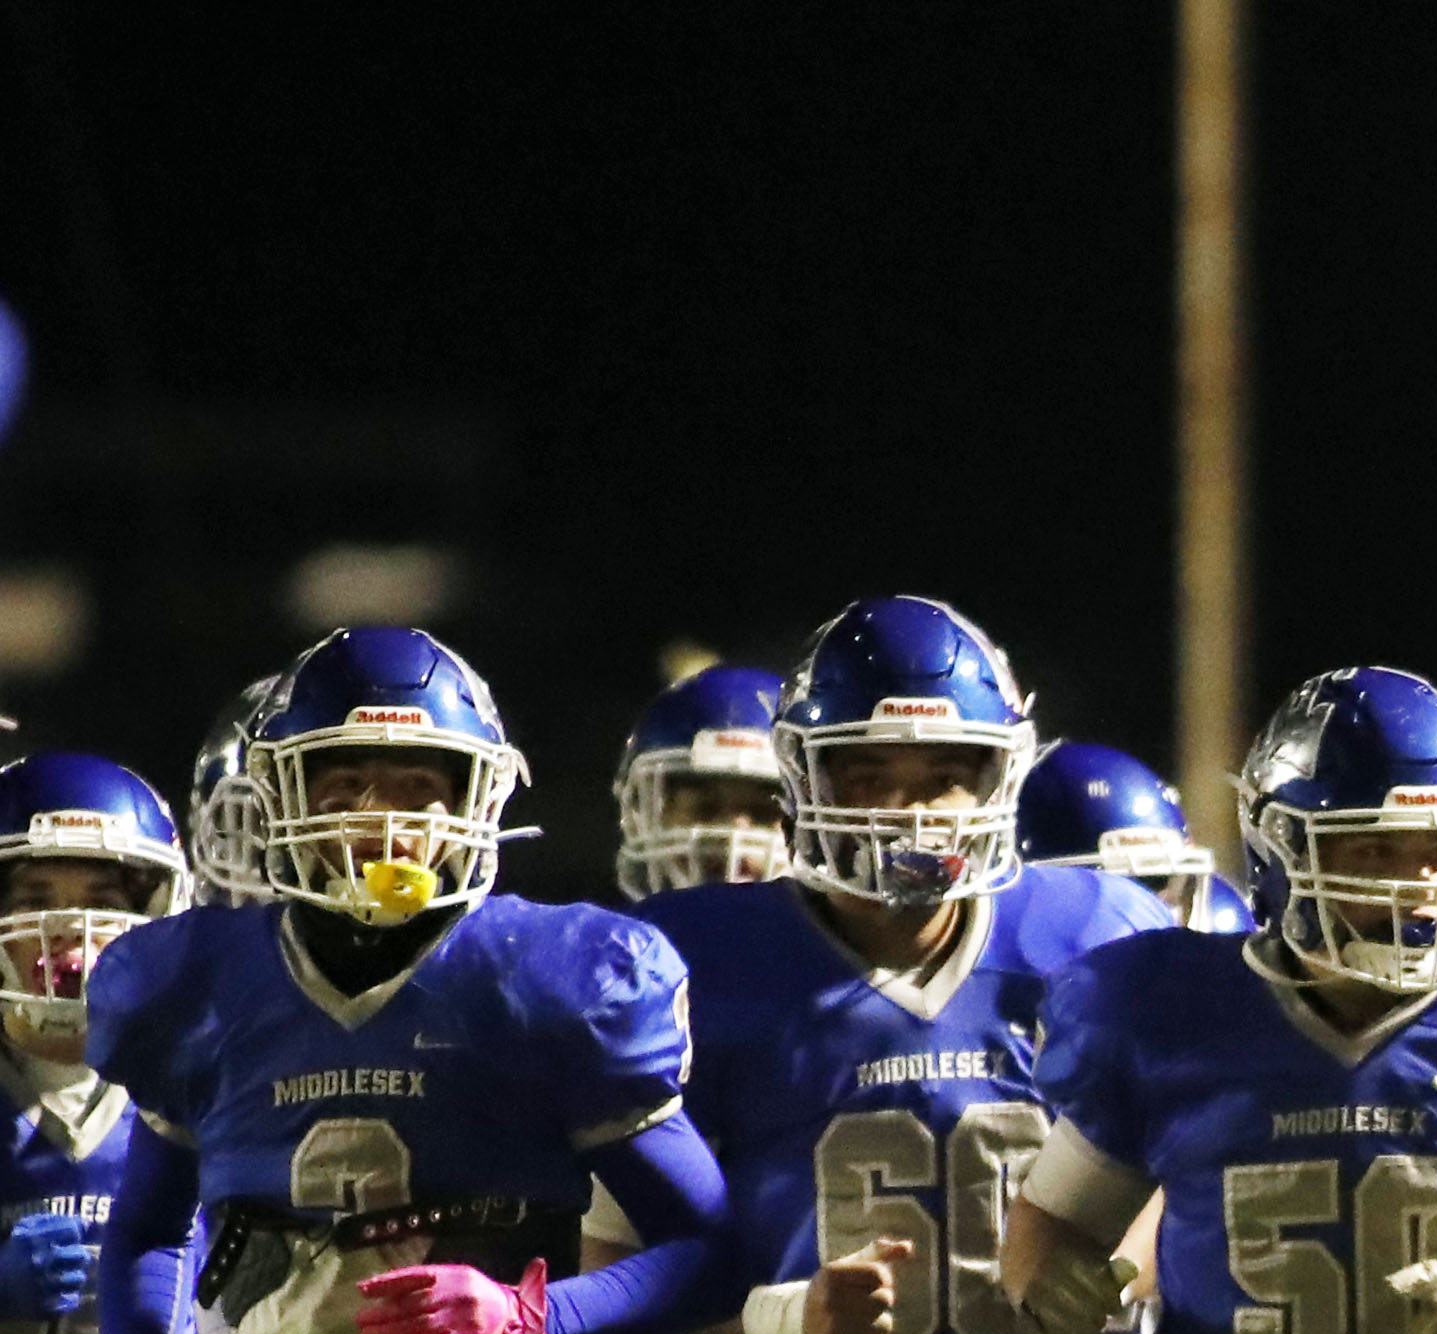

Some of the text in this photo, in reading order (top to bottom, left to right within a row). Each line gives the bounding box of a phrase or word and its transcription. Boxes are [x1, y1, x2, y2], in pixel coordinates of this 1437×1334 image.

[354, 710, 423, 725] Riddell
[882, 703, 948, 717] Riddell
[858, 1050, 1007, 1088] MIDDLESEX
[274, 1068, 427, 1107] MIDDLESEX
[1271, 1104, 1428, 1140] MIDDLESEX
